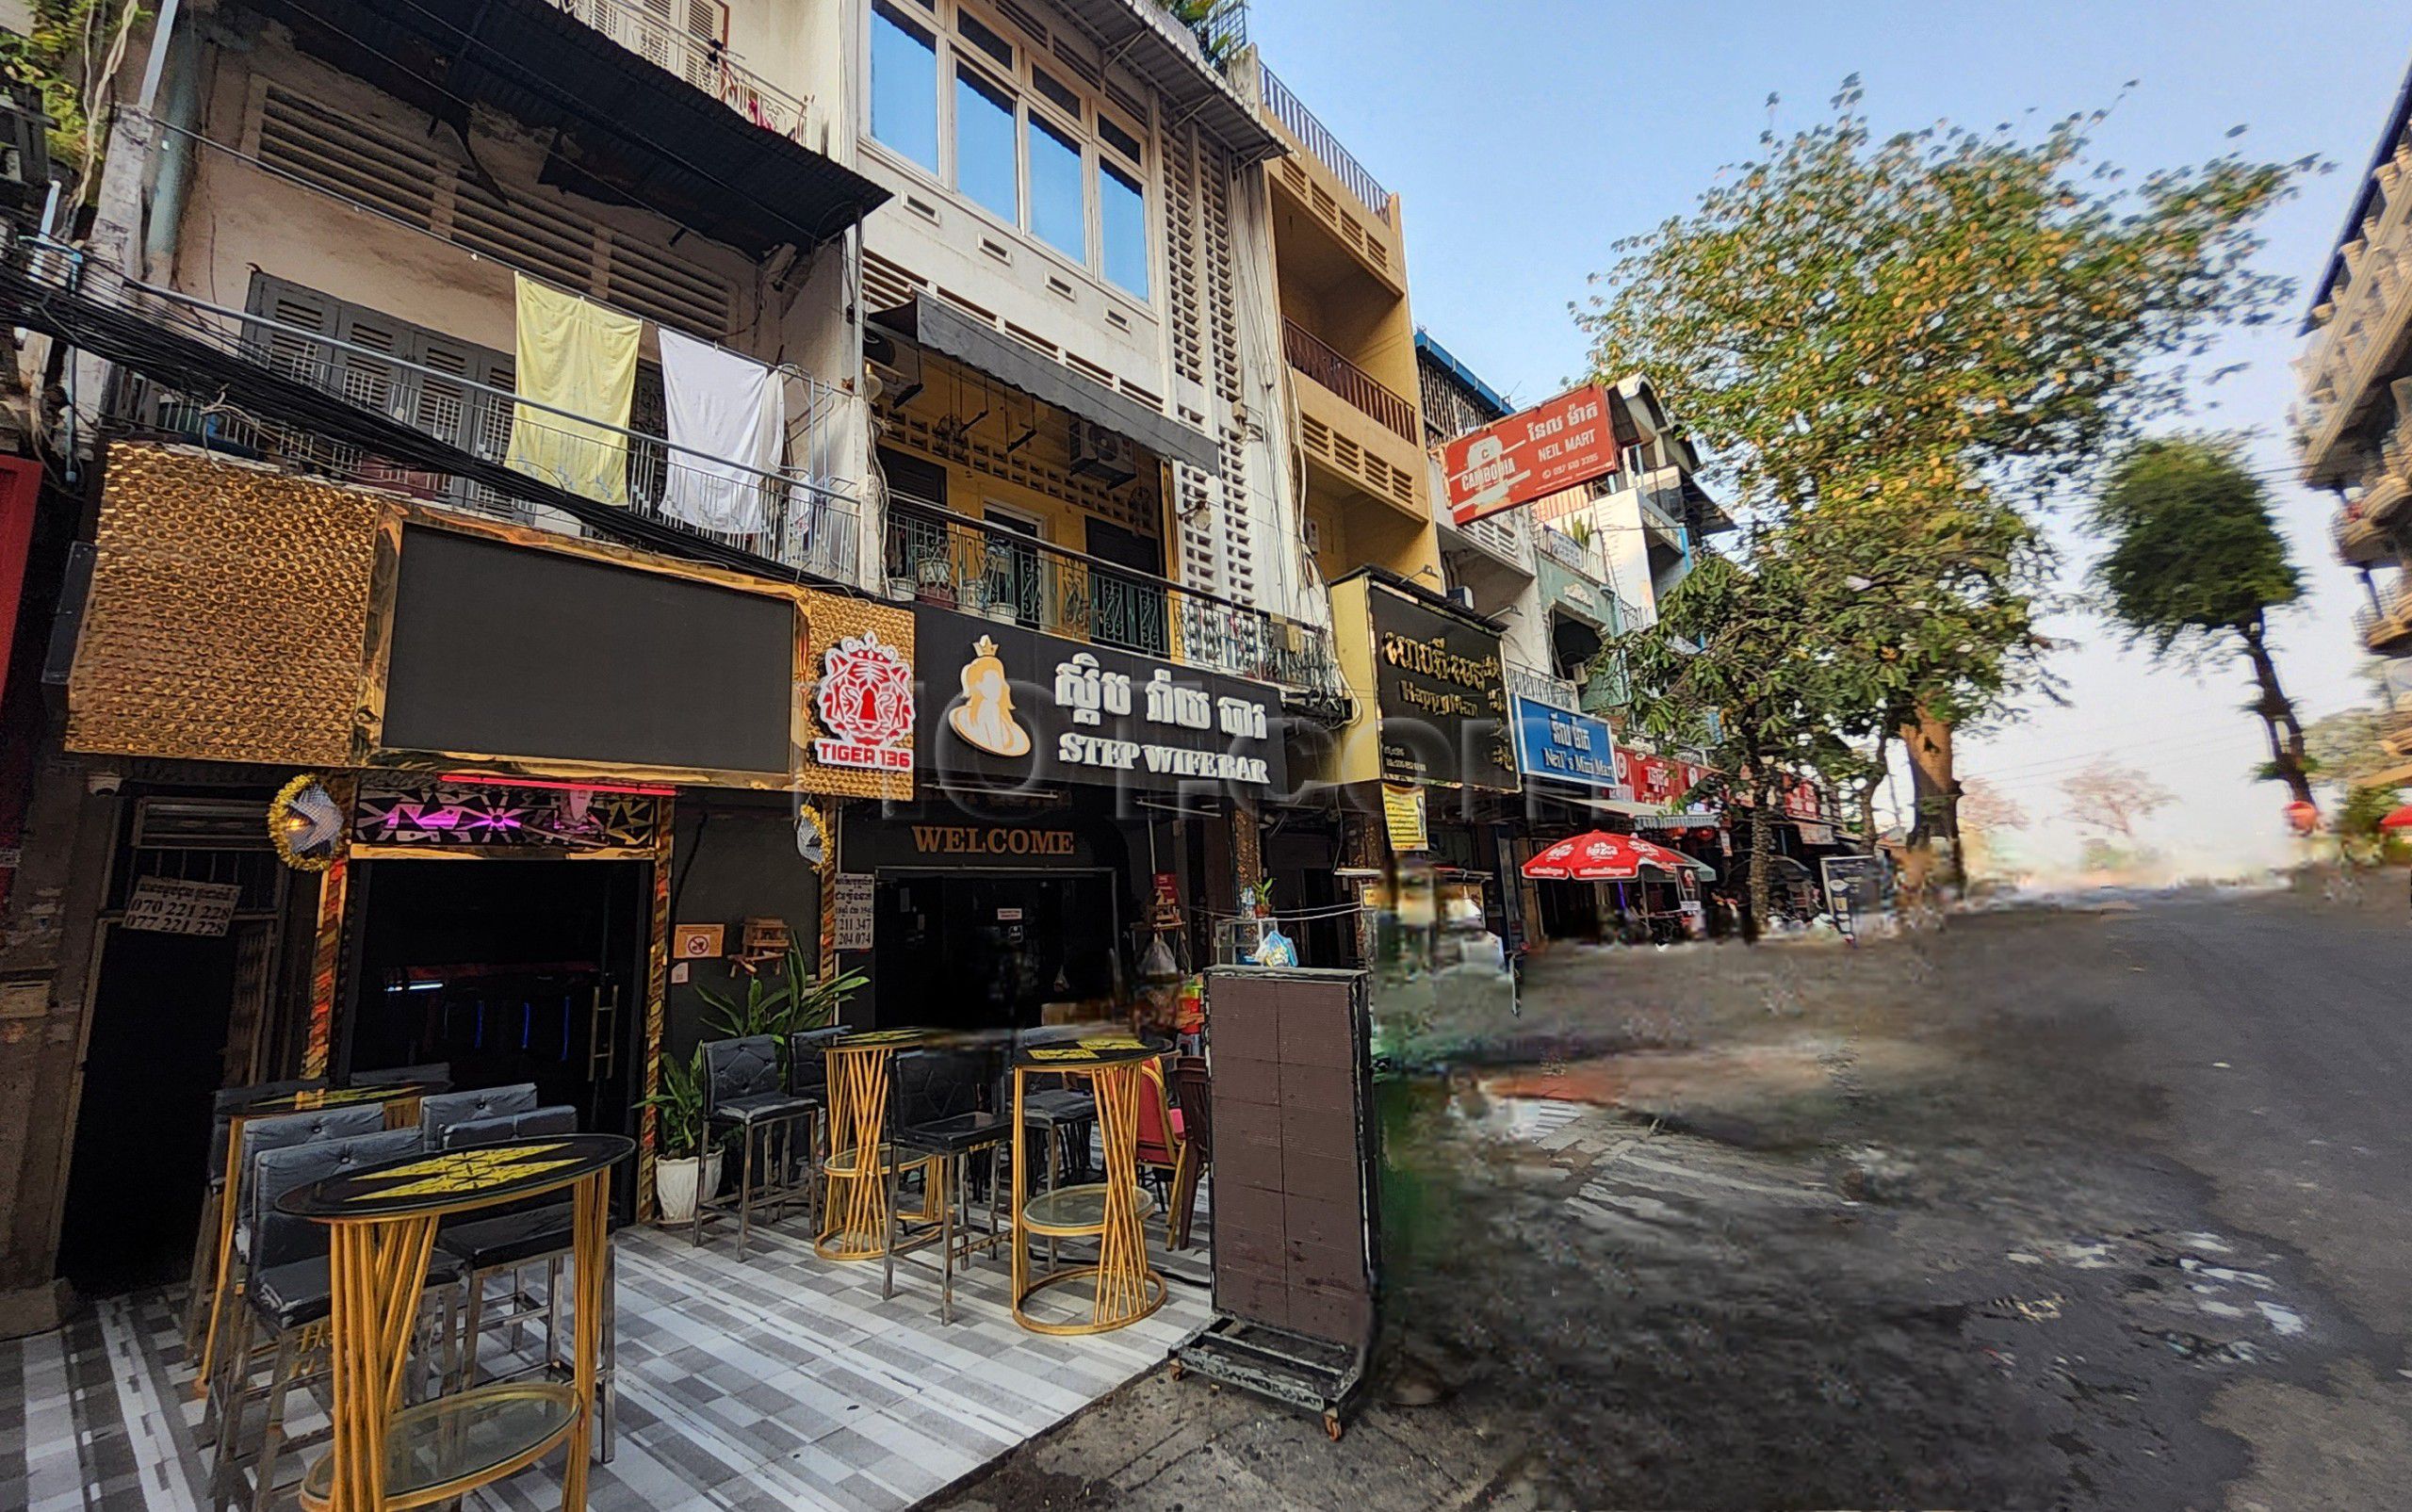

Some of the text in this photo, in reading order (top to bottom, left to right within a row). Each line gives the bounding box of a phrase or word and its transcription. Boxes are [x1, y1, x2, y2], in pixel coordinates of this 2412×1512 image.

[1538, 429, 1596, 463] NEIL MART
[819, 742, 911, 768] TIGER 136
[1059, 732, 1141, 770] STEP
[911, 825, 1075, 854] WELCOME
[166, 902, 195, 917] 221
[200, 905, 232, 919] 228
[161, 918, 190, 932] 221
